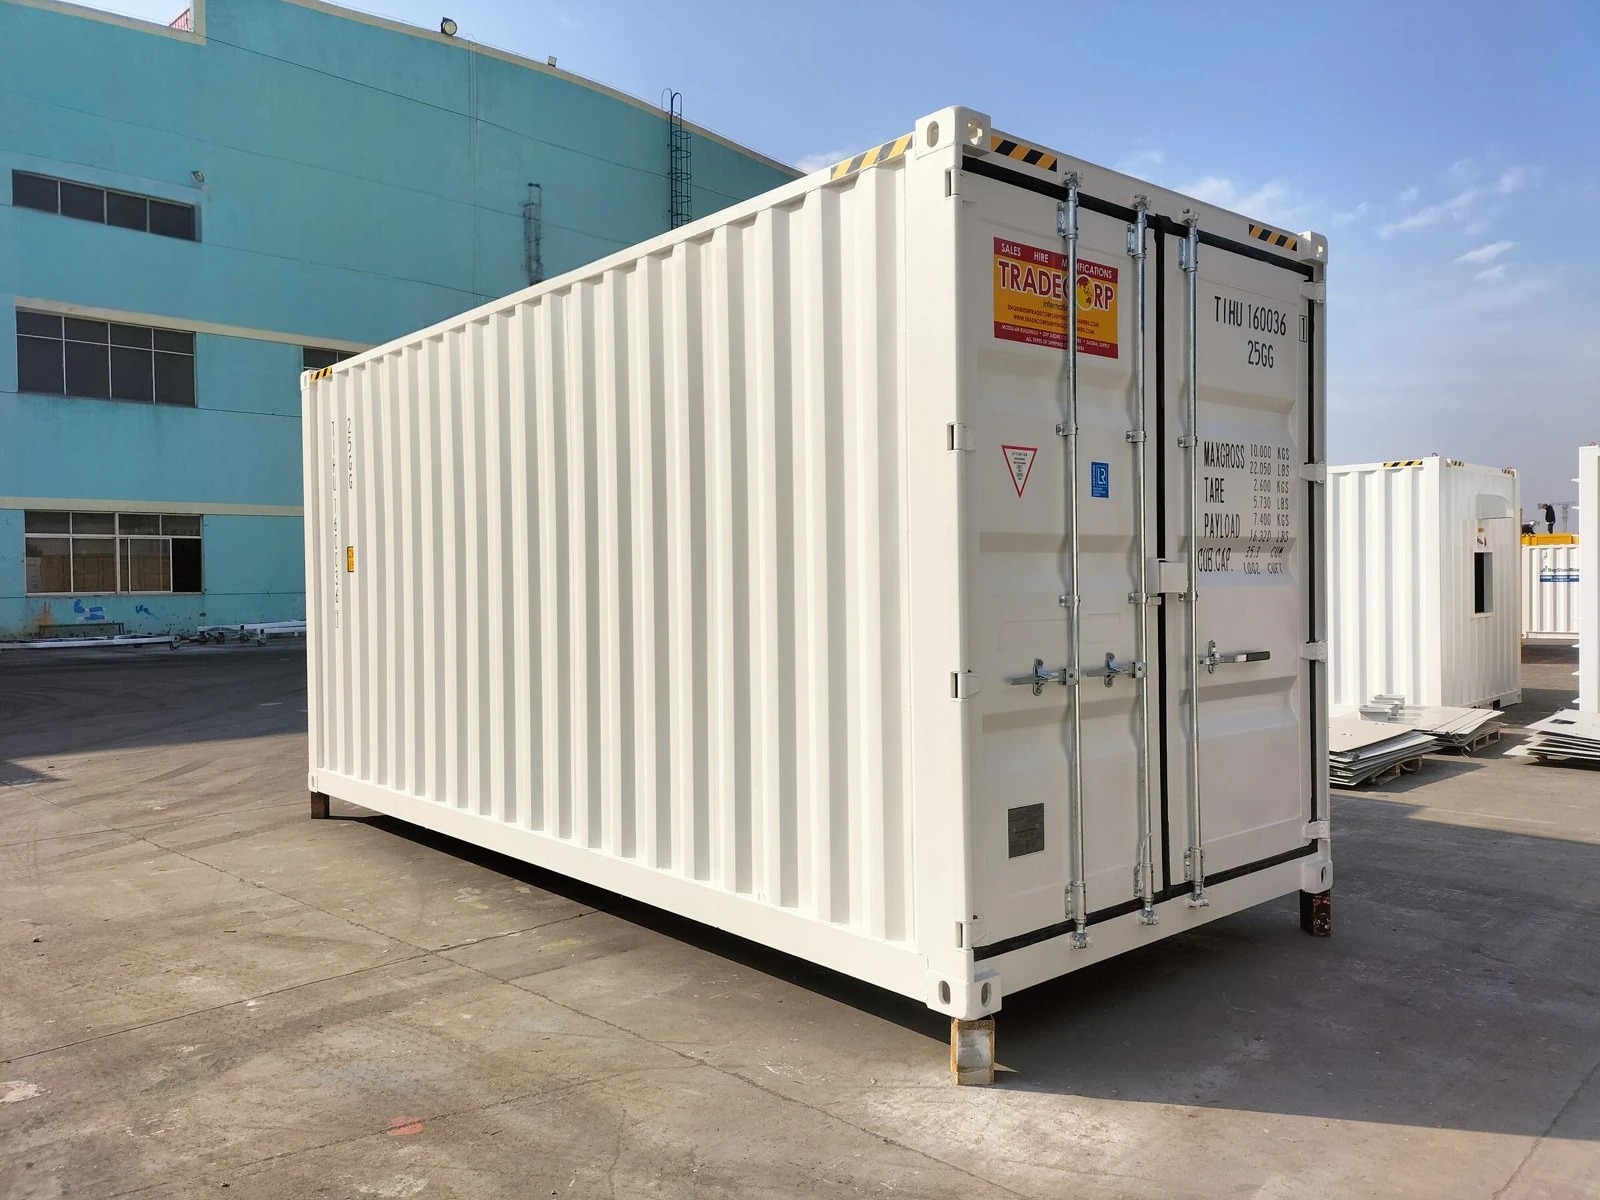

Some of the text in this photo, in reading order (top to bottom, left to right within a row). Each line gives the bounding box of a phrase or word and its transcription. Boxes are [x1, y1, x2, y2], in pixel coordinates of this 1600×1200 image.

[1001, 243, 1113, 279] SALES HIRE MIFICATIONS
[1215, 296, 1243, 327] TIHU
[1248, 304, 1287, 336] 160036
[1248, 340, 1274, 369] 25GG
[1204, 441, 1290, 469] MAXGROSS 10.000 KGS
[1250, 461, 1290, 477] 22.050 LBS
[1204, 477, 1225, 504] TARE
[1277, 480, 1289, 494] KGS
[1253, 495, 1289, 510] 5.730 LBS
[1204, 512, 1289, 539] PAYLOAD 7.400 KGS
[1276, 530, 1289, 543] LBS
[1197, 547, 1234, 573] CUB.CAP.
